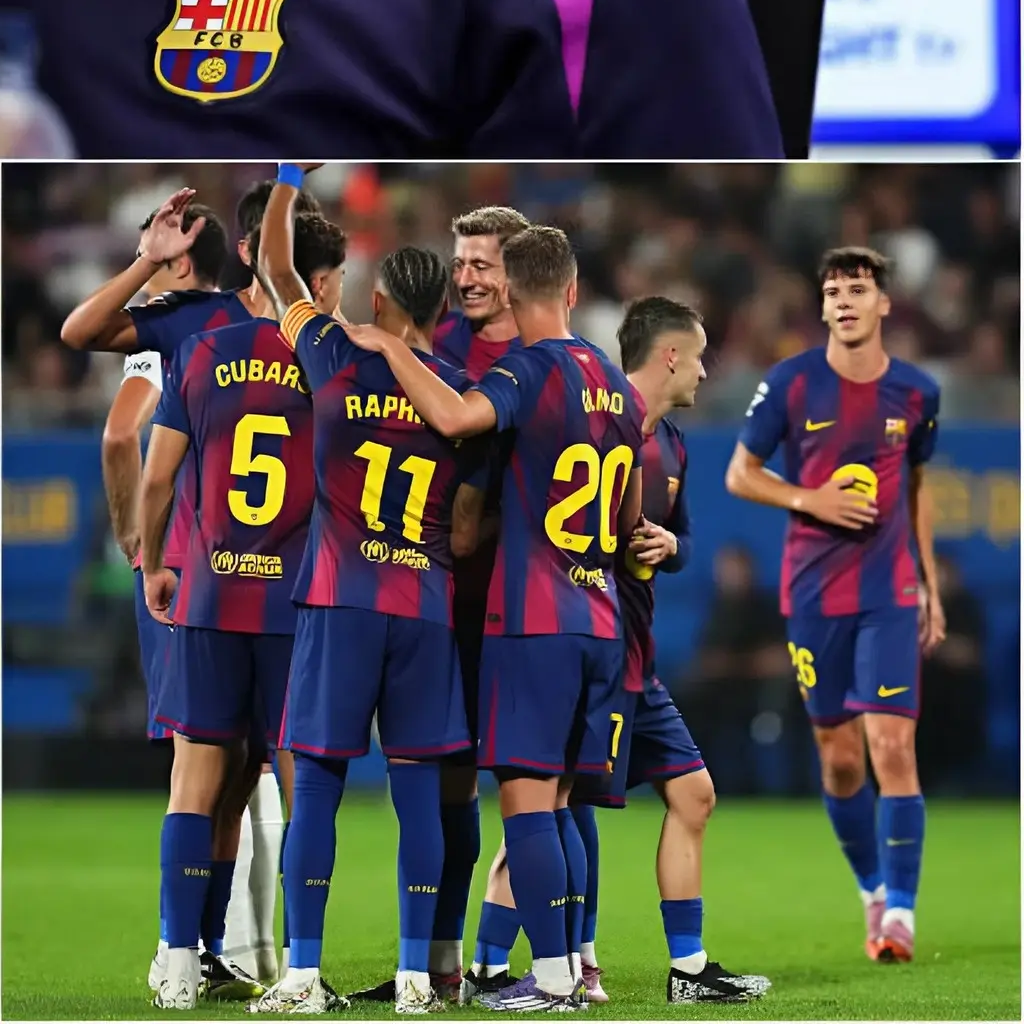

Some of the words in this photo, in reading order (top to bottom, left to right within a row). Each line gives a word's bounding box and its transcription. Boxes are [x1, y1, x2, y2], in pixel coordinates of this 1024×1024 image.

[194, 31, 243, 49] FCB
[346, 394, 426, 425] RAPH
[228, 413, 291, 526] 5
[354, 440, 437, 543] 11
[545, 443, 633, 554] 20
[610, 712, 624, 758] 7
